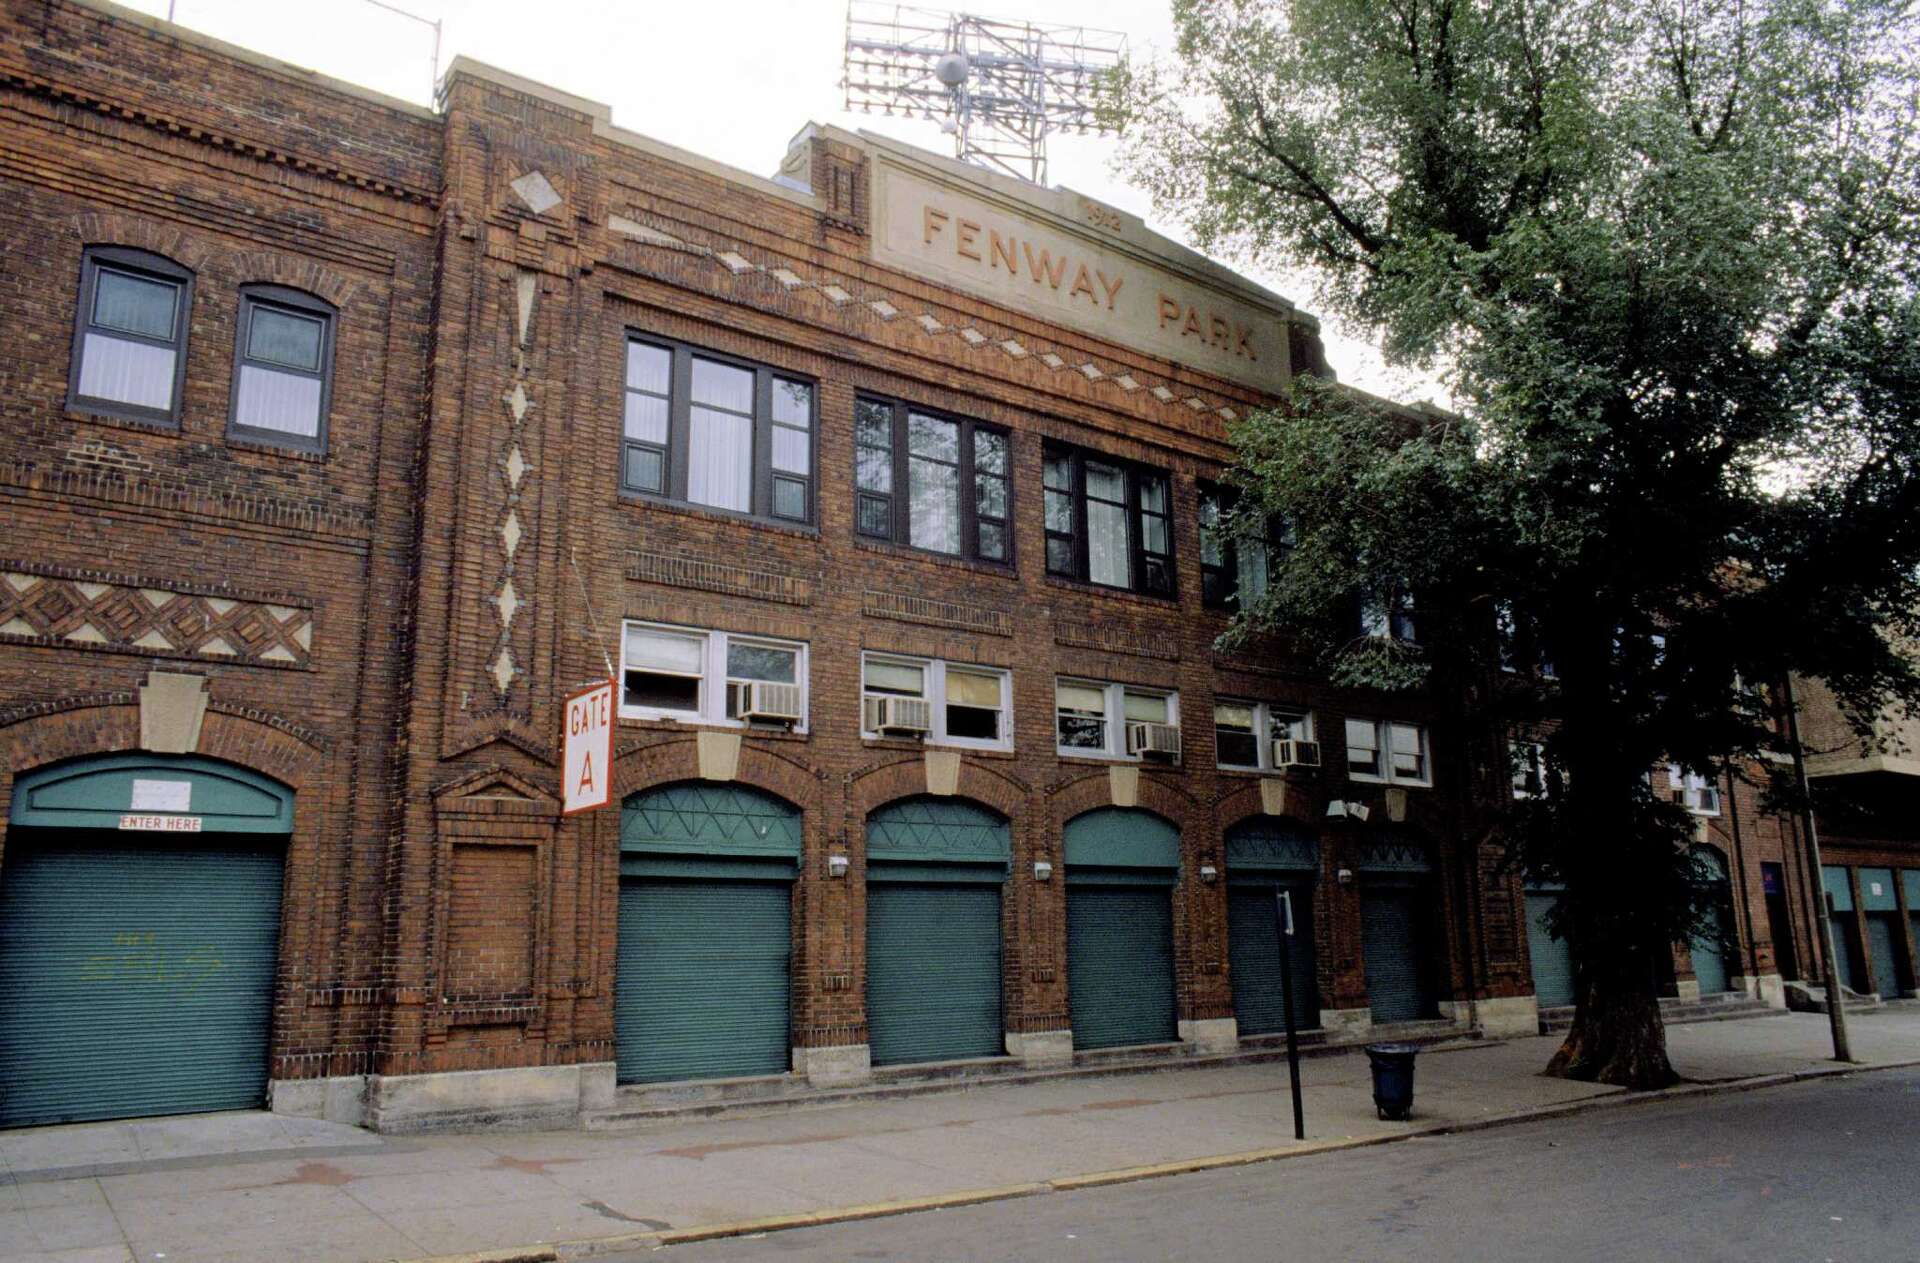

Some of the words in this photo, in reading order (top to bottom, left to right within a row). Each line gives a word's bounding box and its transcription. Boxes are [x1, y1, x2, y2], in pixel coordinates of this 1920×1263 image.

[923, 205, 1124, 310] FENWAY
[1156, 290, 1257, 361] PARK
[571, 692, 608, 737] GATE
[577, 751, 594, 797] A
[121, 815, 161, 829] ENTER
[166, 817, 200, 831] HERE
